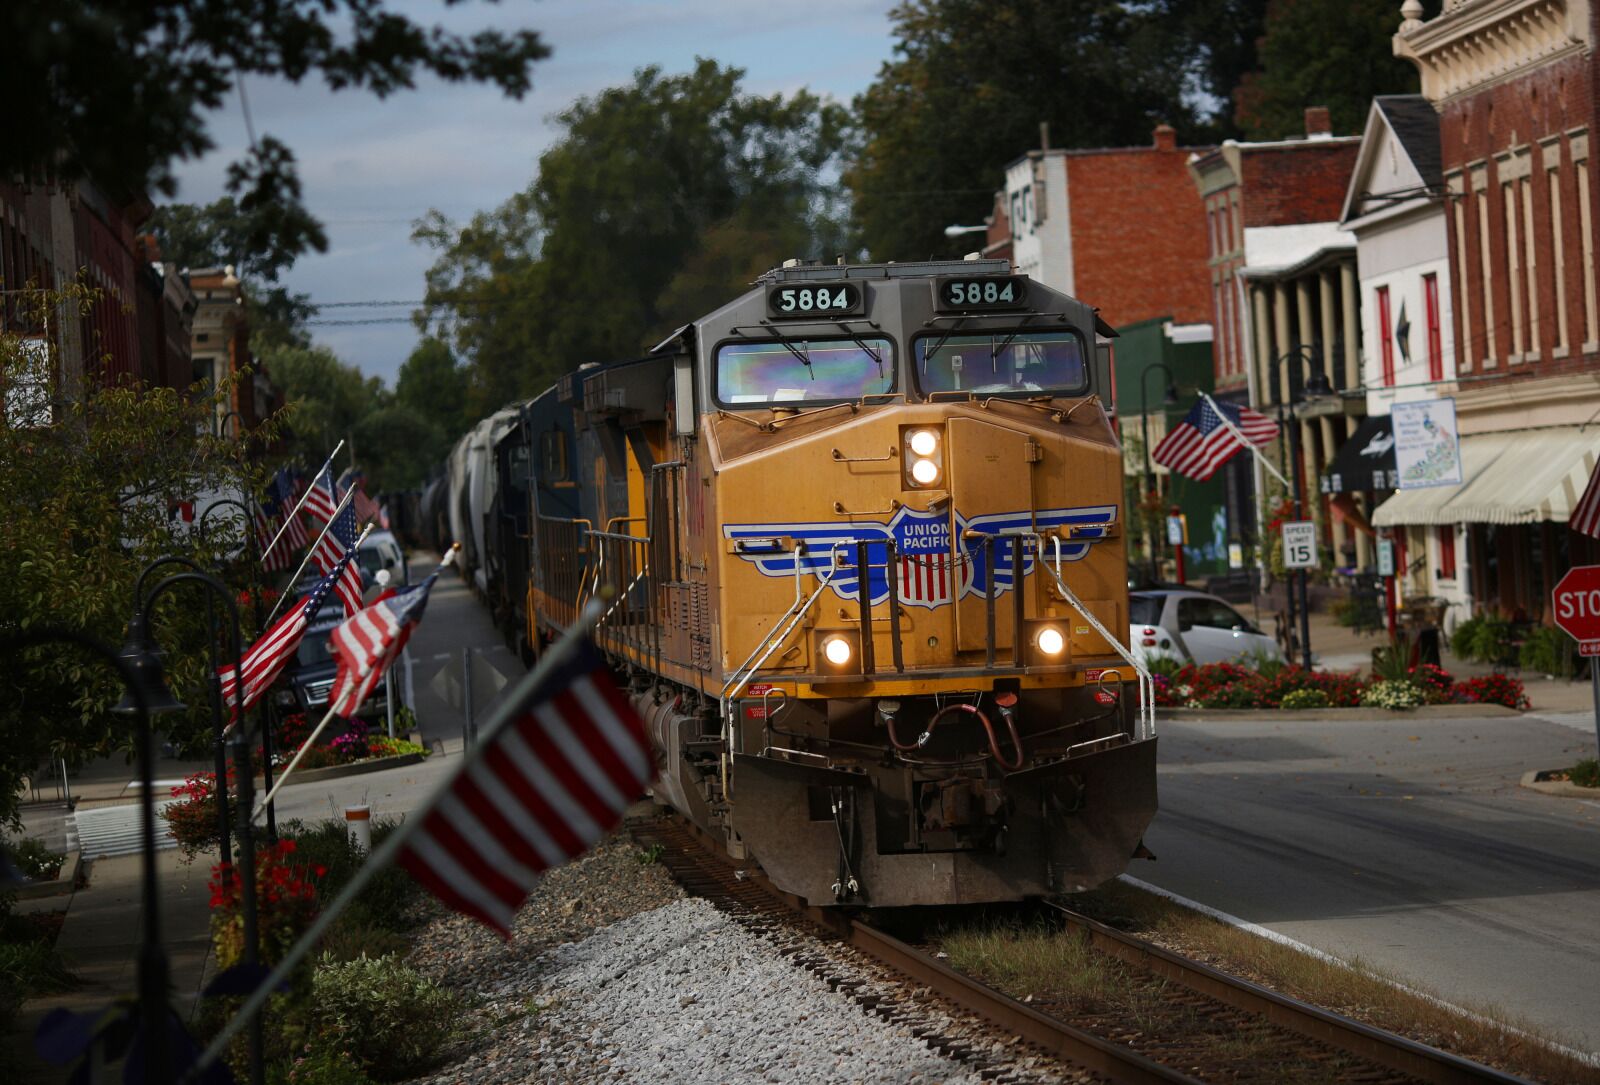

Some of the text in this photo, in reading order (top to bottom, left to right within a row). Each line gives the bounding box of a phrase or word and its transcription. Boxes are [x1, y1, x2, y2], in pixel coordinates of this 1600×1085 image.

[781, 287, 848, 311] 5884
[950, 281, 1014, 304] 5884
[904, 523, 950, 536] UNION
[1286, 526, 1312, 534] SPEED
[903, 536, 951, 549] PACIFIC
[1288, 535, 1310, 544] LIMIT
[1289, 545, 1311, 563] 15
[1559, 589, 1600, 619] STO
